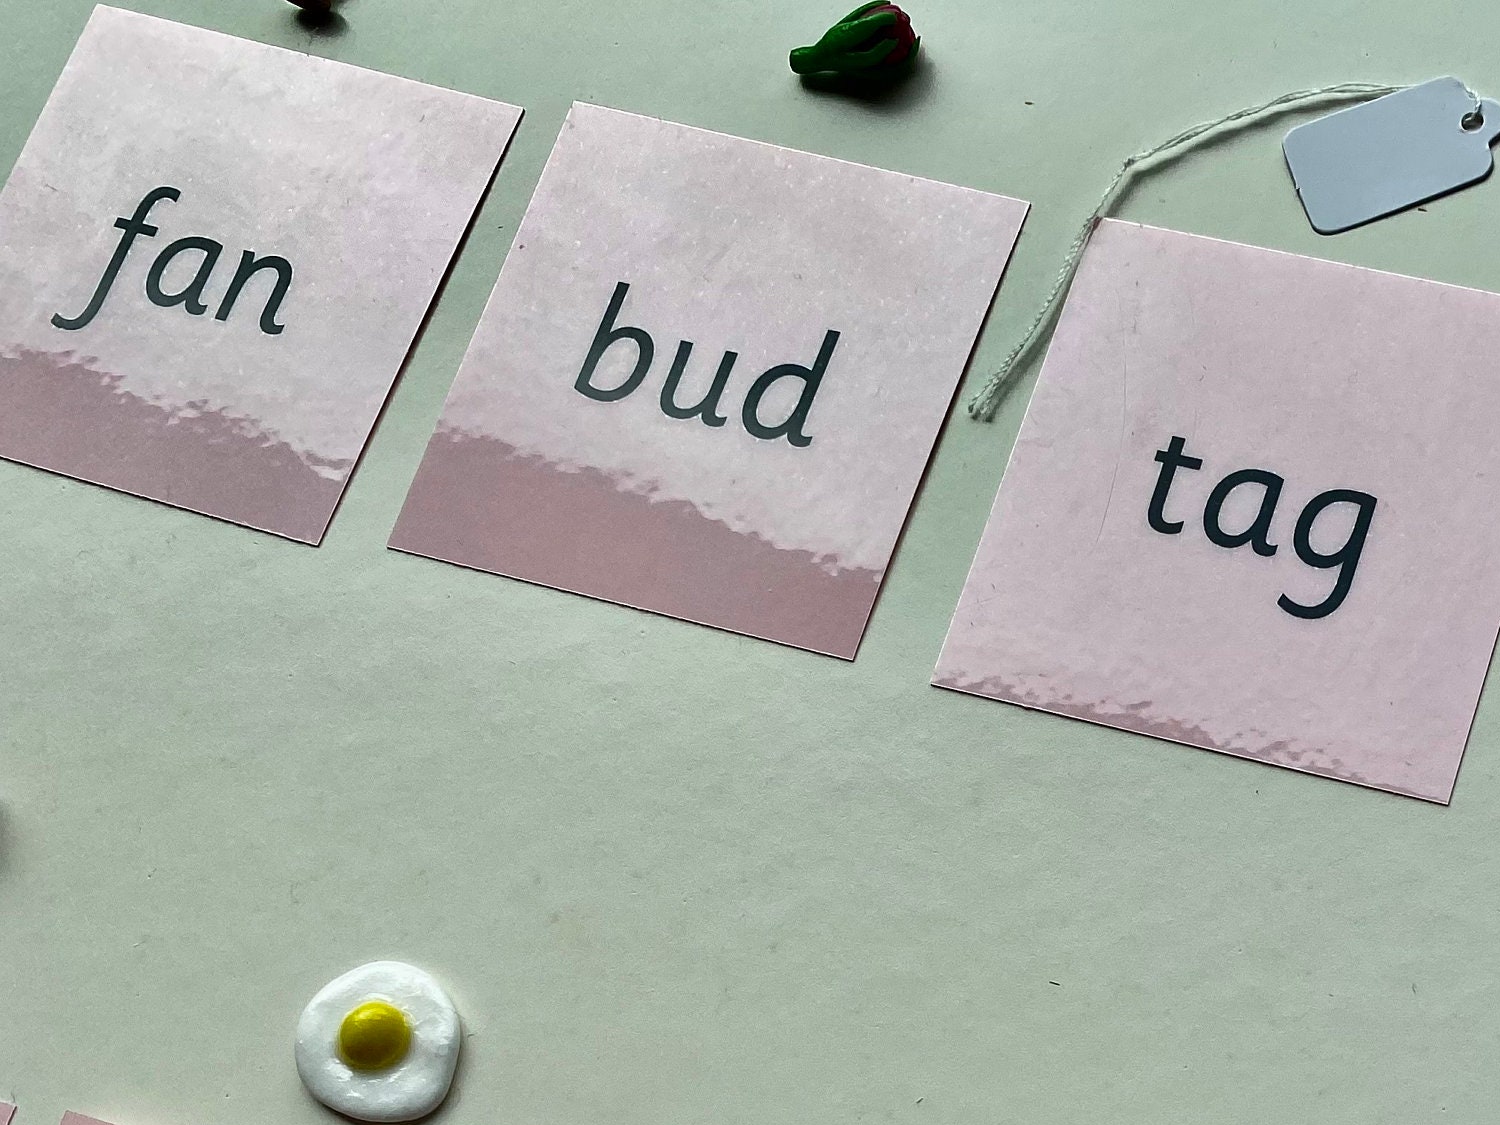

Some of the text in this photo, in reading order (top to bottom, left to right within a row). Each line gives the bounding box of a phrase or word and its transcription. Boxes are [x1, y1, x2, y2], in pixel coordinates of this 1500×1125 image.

[50, 186, 293, 335] fan
[573, 281, 841, 448] bud
[1147, 435, 1378, 620] tag
